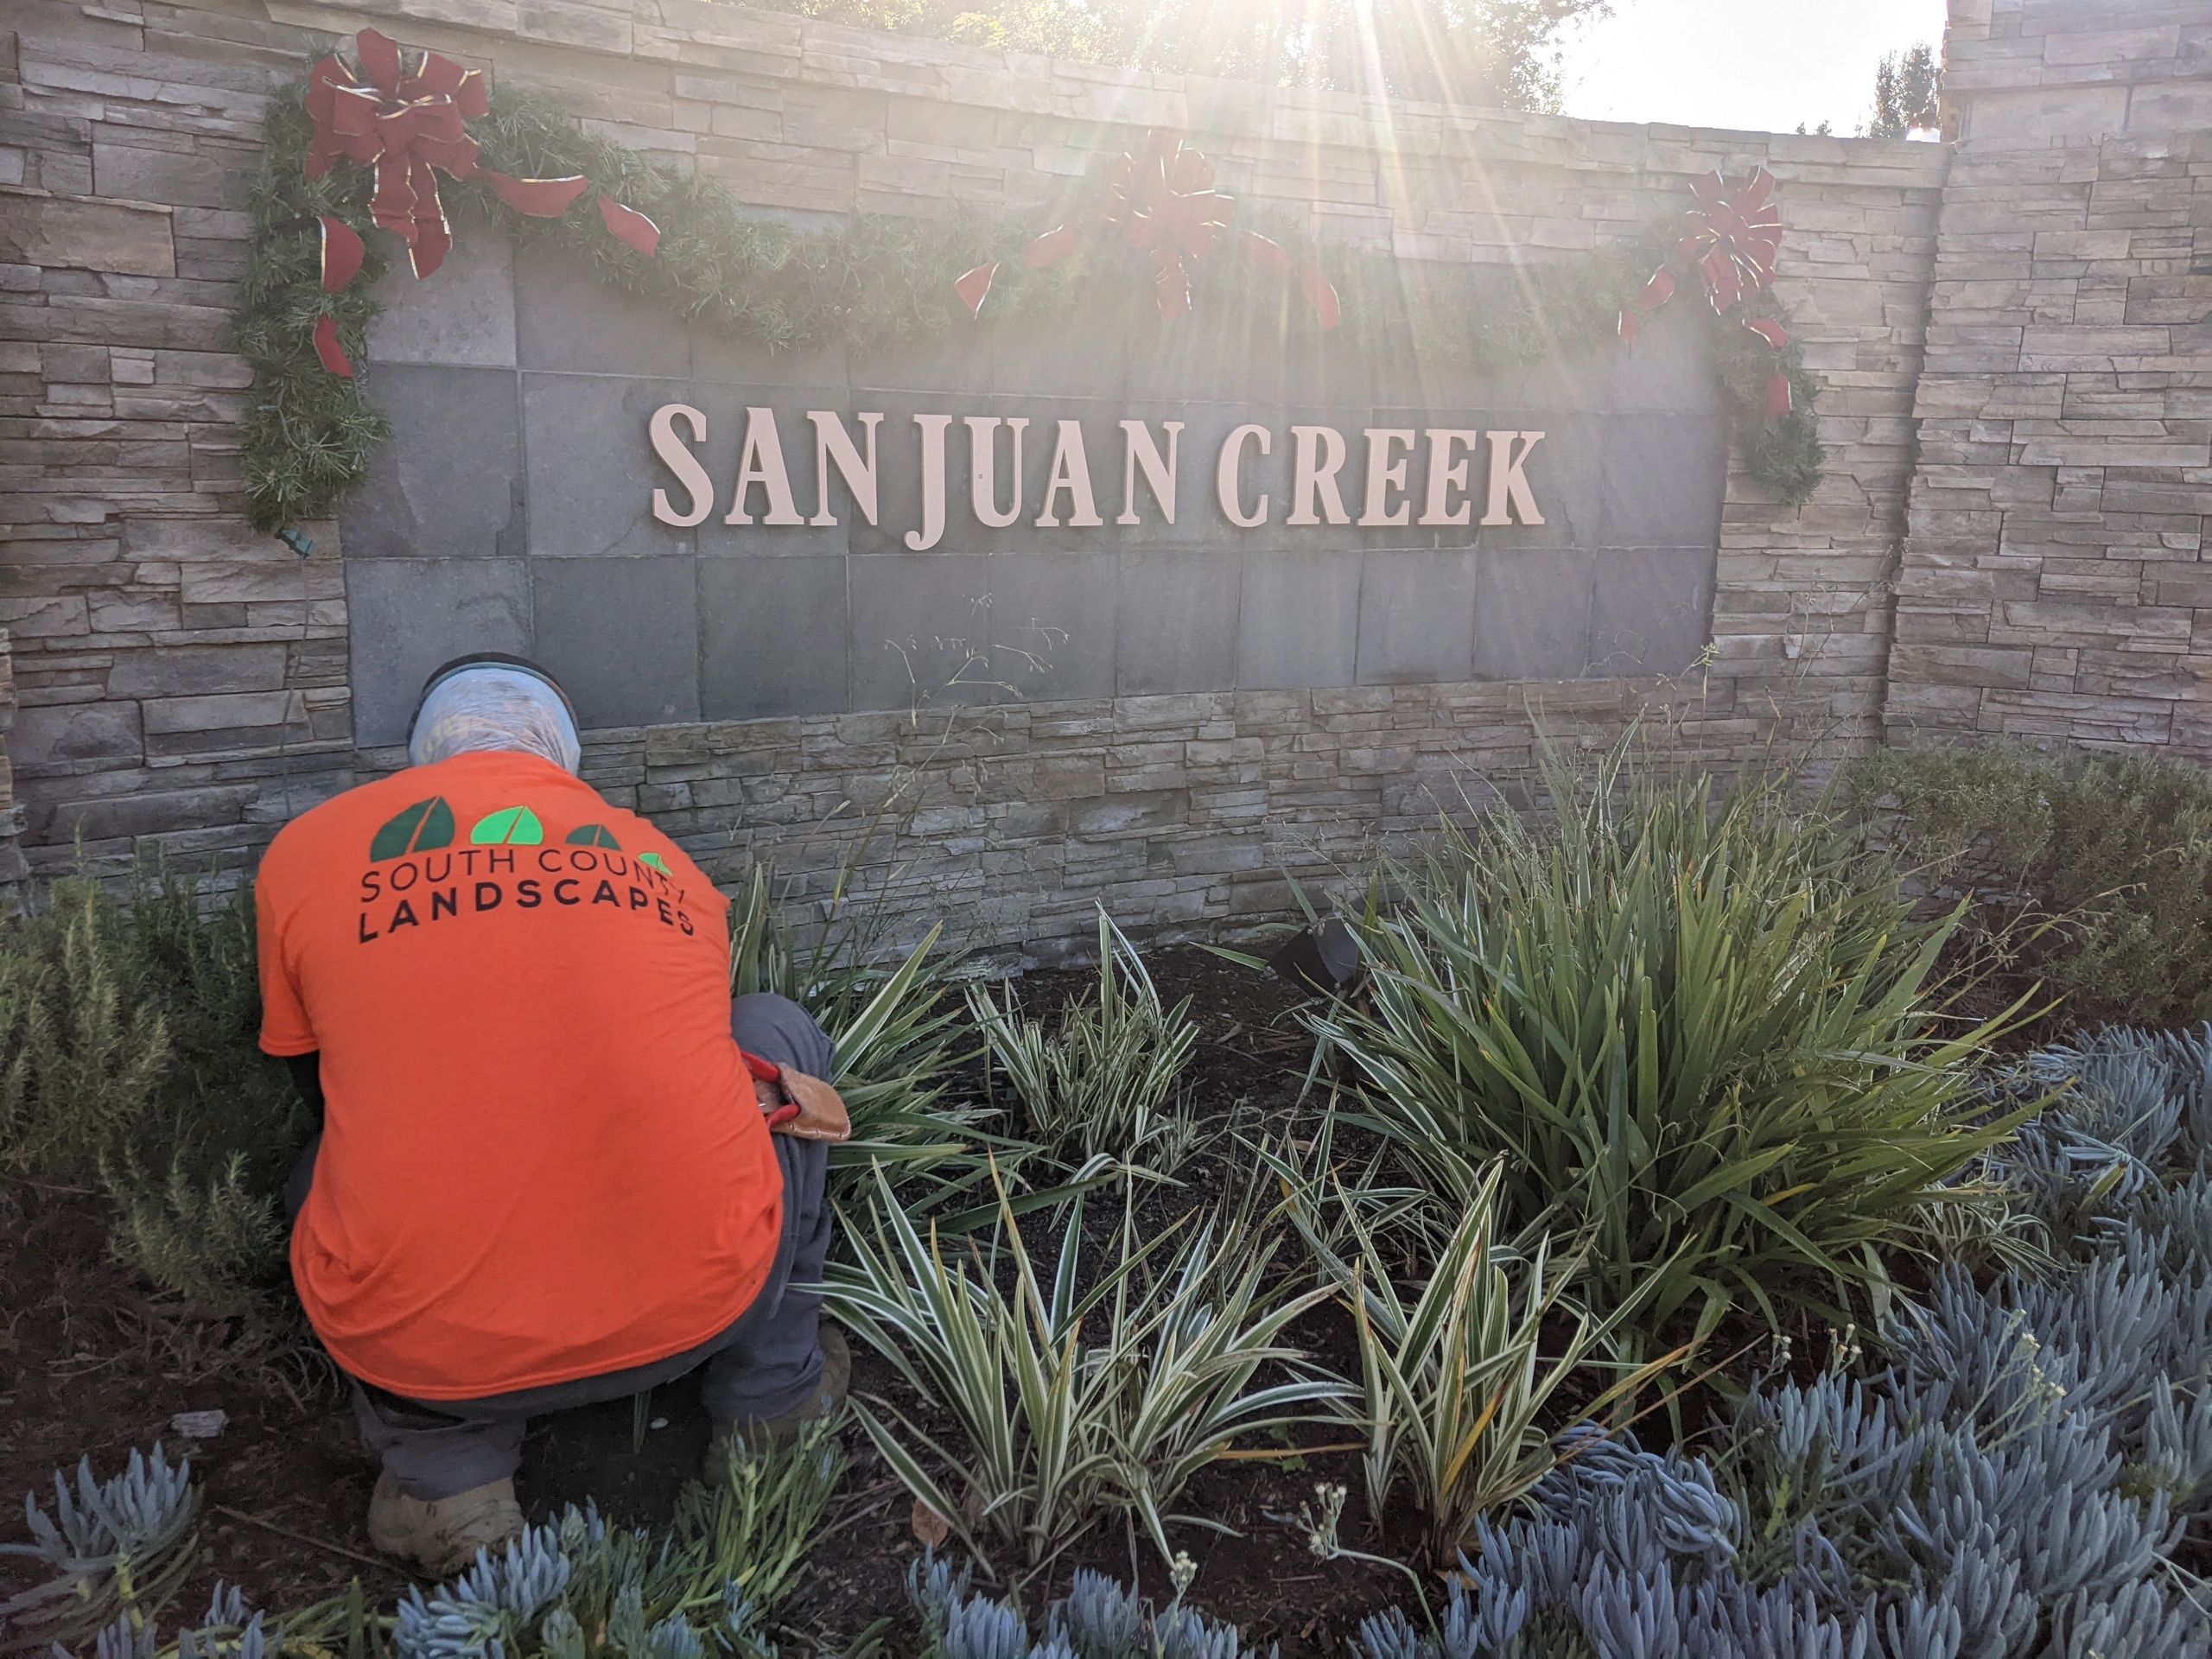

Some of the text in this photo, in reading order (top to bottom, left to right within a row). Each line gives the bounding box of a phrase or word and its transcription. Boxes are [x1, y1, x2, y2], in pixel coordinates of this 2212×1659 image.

[649, 404, 1547, 551] SAN JUAN CREEK
[359, 848, 515, 903] SOUTH
[359, 879, 695, 944] LANDSCAPES
